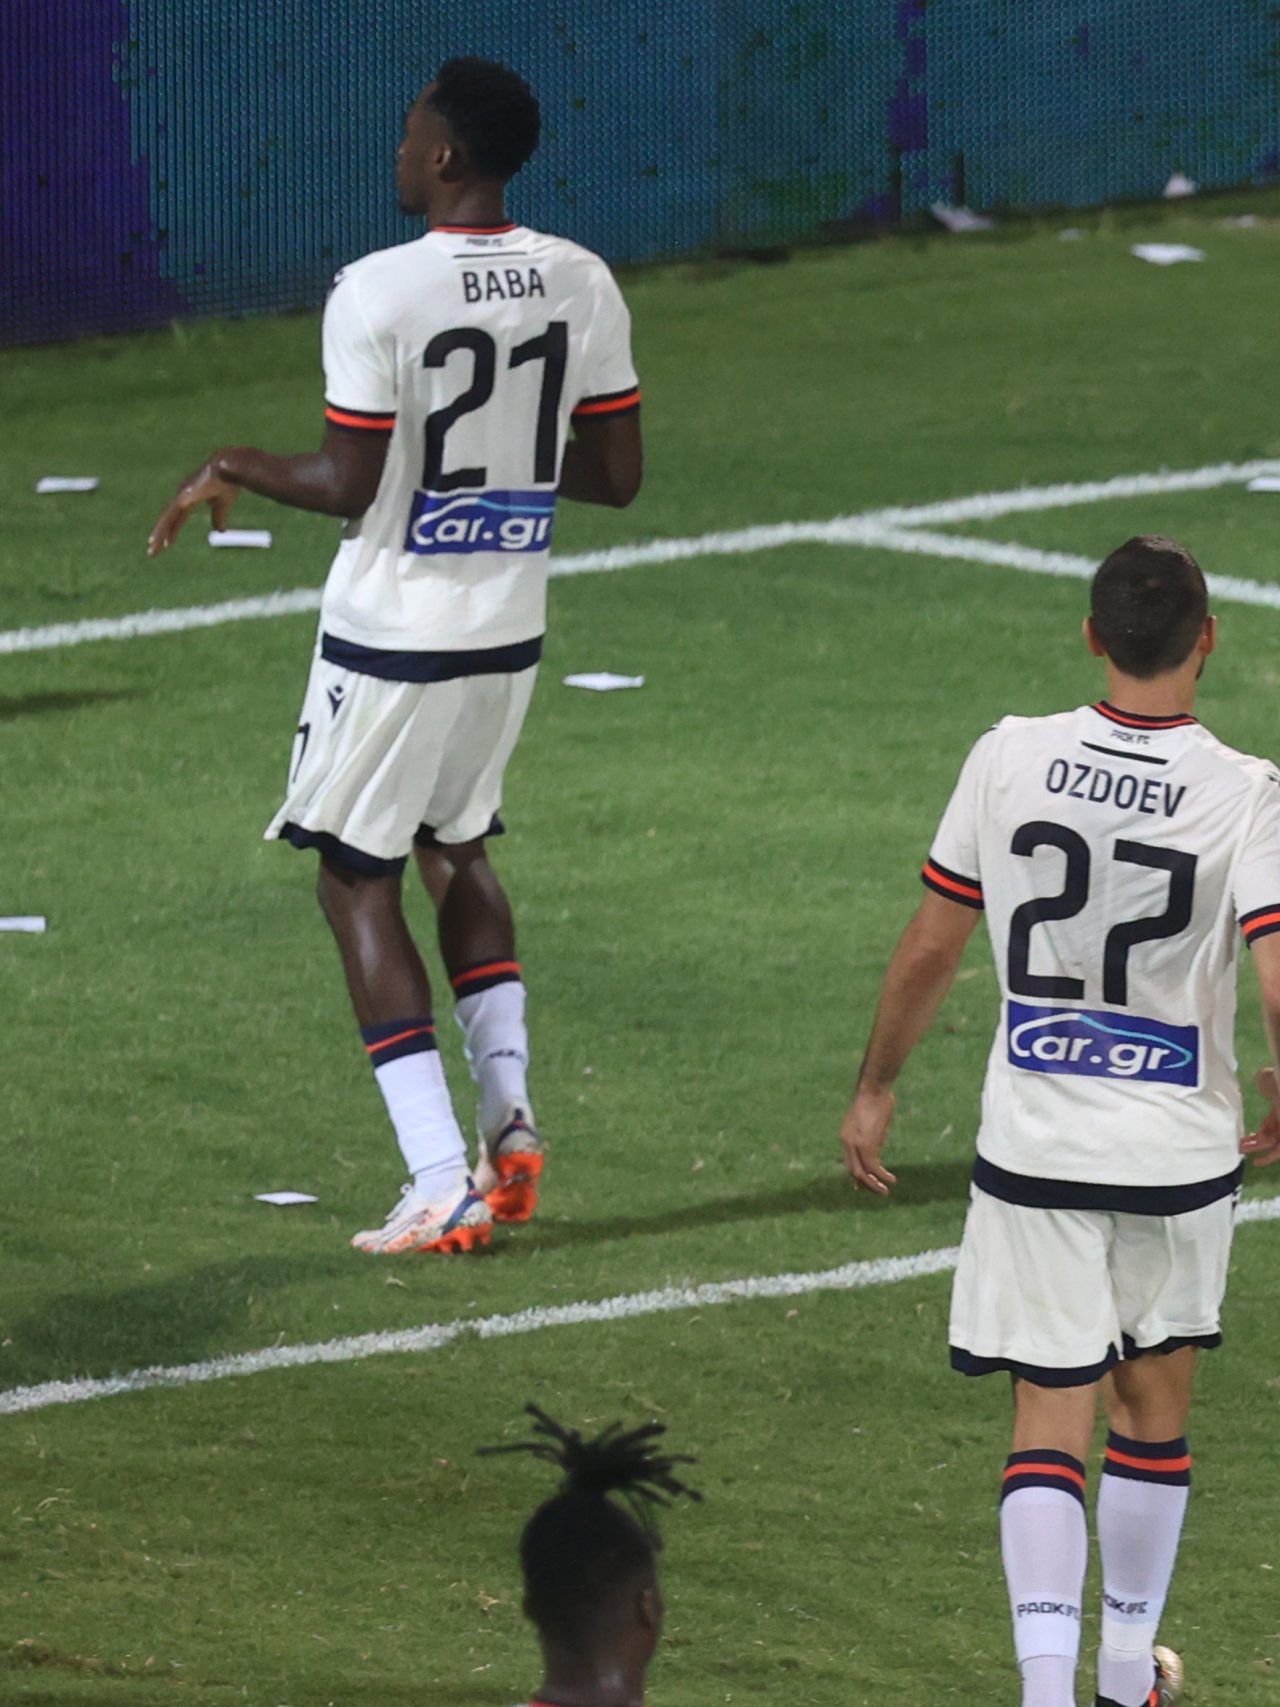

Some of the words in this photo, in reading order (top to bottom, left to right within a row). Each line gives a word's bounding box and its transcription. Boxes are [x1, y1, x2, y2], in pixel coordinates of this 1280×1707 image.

[462, 268, 546, 303] BABA
[423, 320, 568, 492] 21
[1047, 758, 1187, 818] OZDOEV
[1008, 821, 1198, 1006] 27
[1017, 1601, 1065, 1618] PAOK
